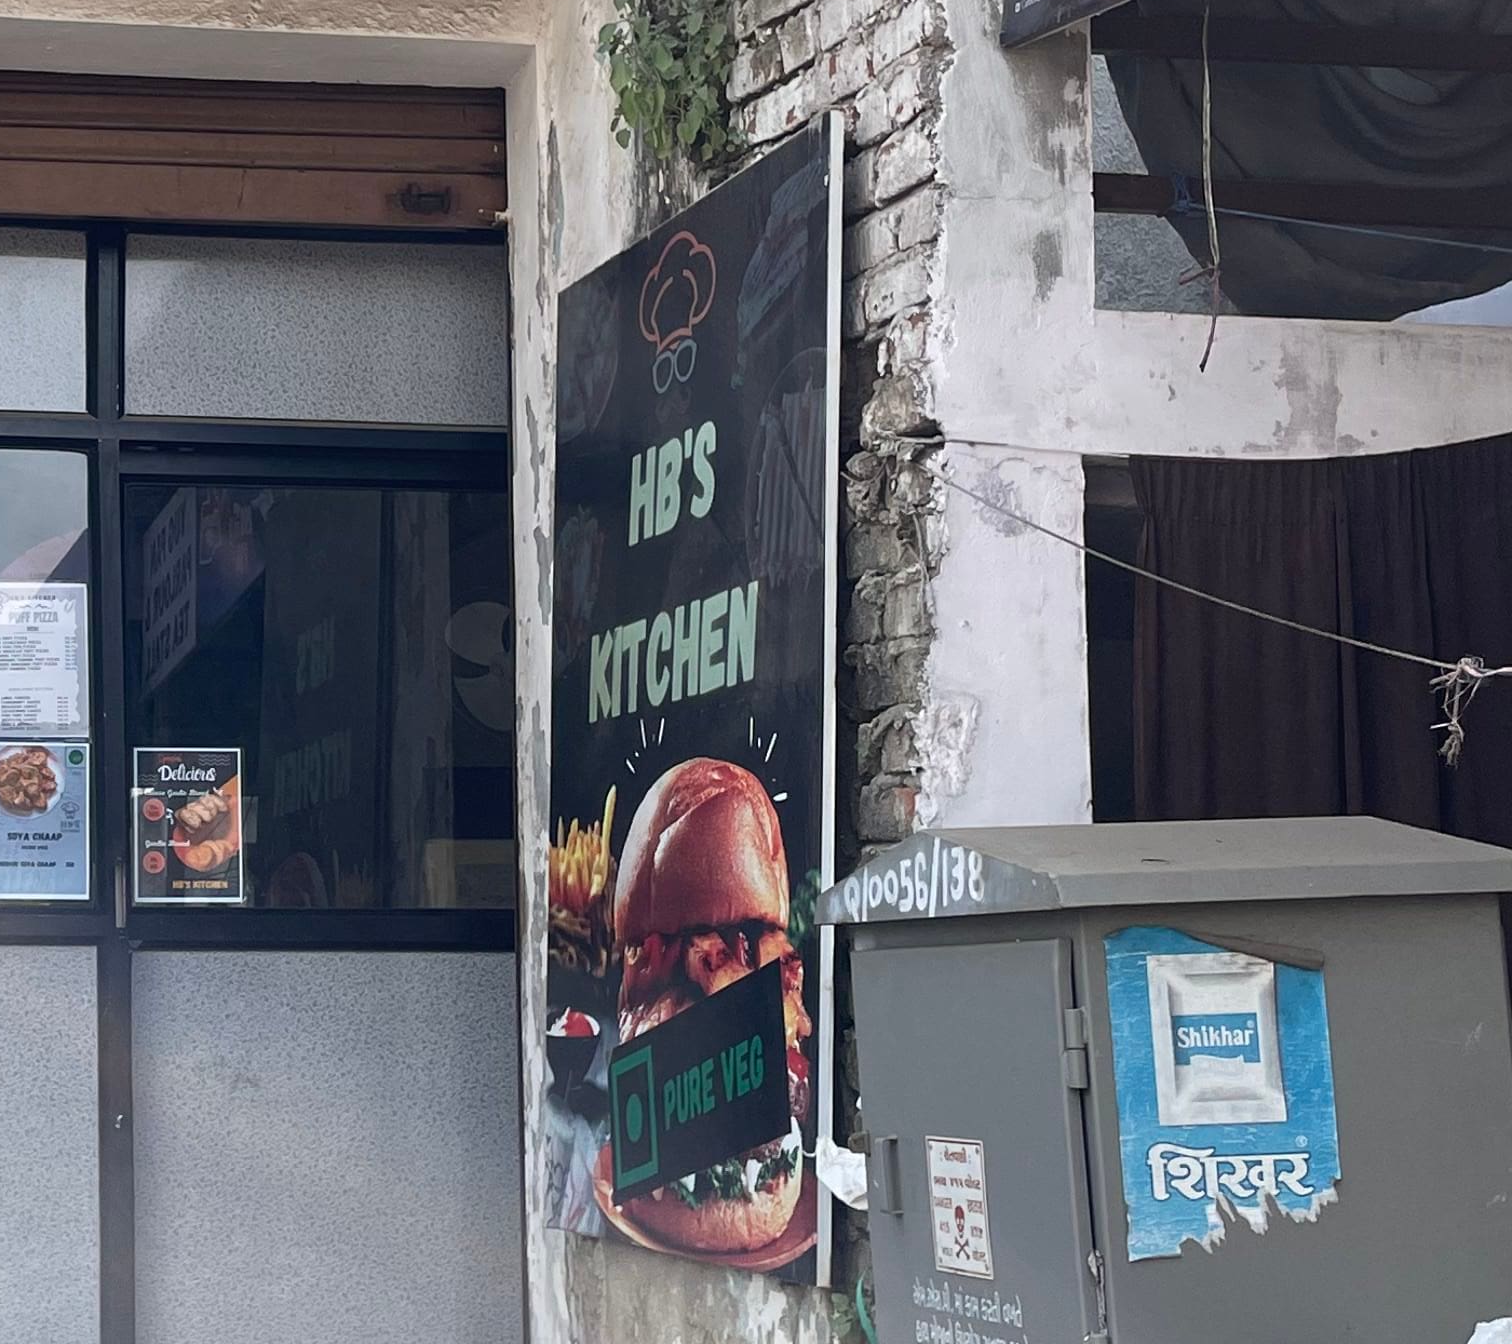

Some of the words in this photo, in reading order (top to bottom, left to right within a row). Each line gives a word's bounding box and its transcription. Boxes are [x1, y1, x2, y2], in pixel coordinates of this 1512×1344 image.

[628, 420, 716, 547] HB'S
[588, 580, 759, 725] KITCHEN
[158, 763, 217, 782] Delicious
[1177, 1025, 1254, 1048] Shikhar
[663, 1055, 716, 1132] PURE
[720, 1033, 765, 1105] VEG
[1146, 1142, 1315, 1202] शिखर
